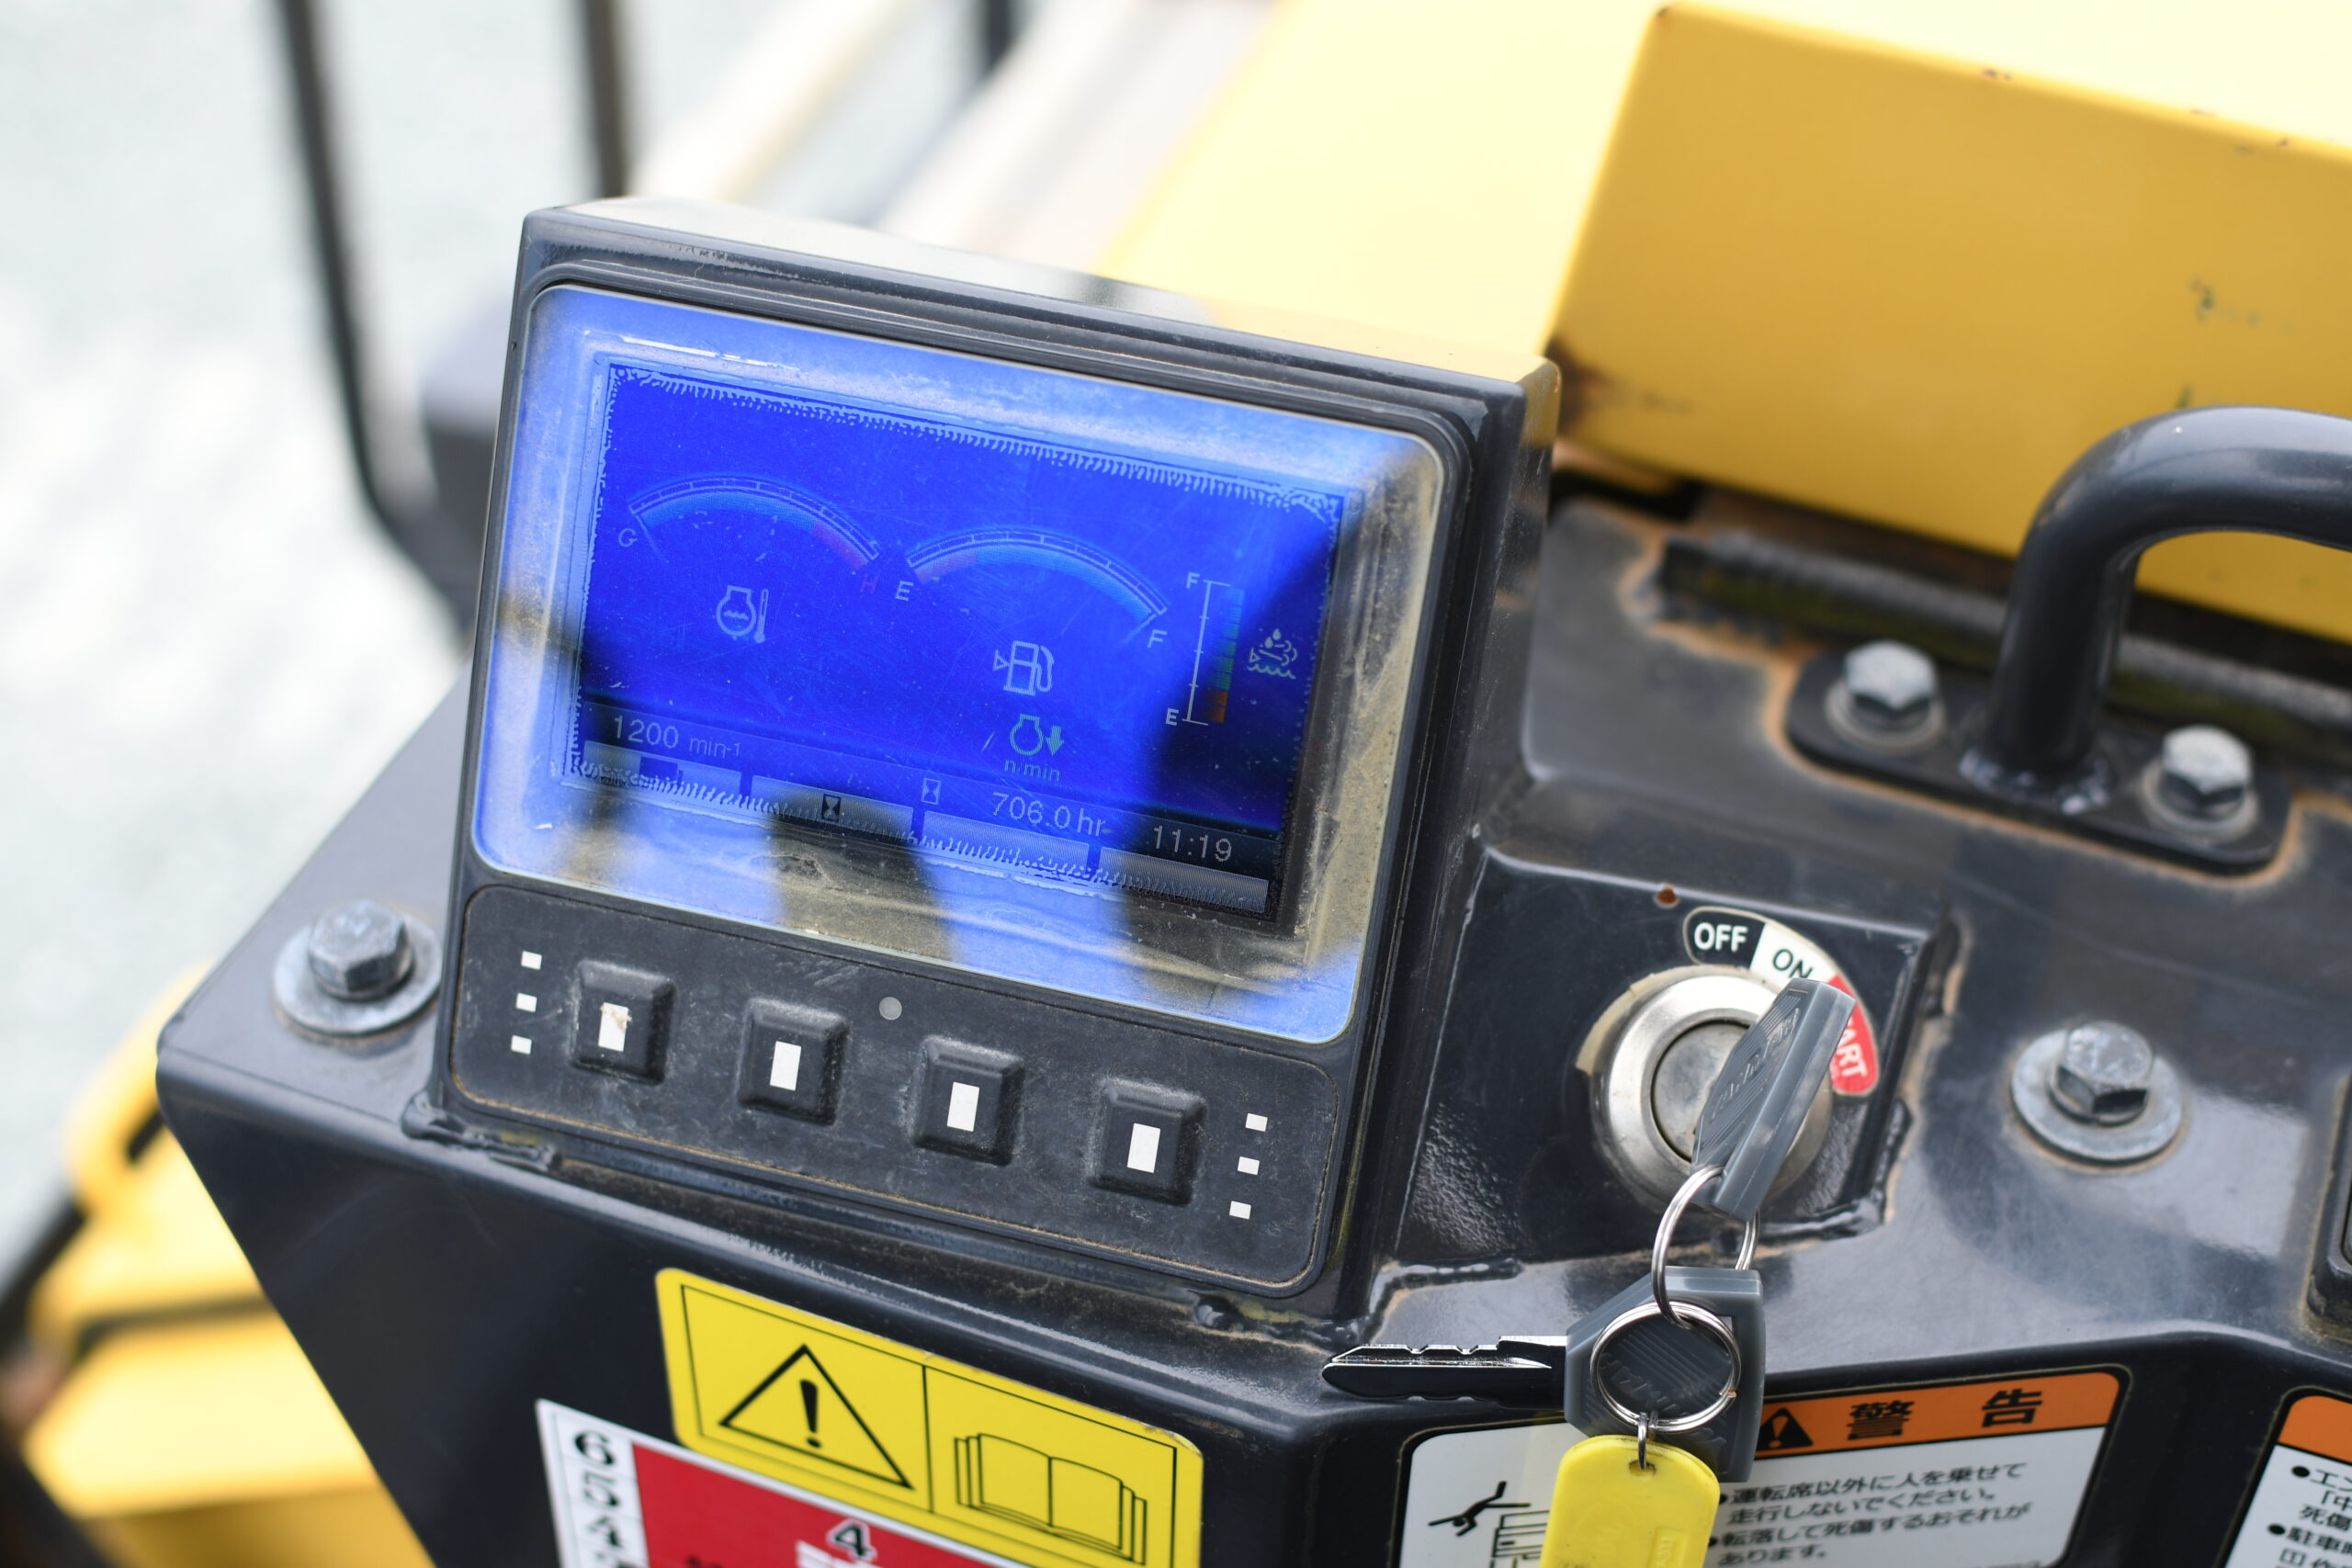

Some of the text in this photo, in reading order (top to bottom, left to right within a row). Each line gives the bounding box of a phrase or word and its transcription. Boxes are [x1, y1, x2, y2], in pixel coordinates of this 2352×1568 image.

[895, 581, 914, 602] E
[1186, 572, 1200, 589] F
[1148, 629, 1168, 649] F
[613, 715, 680, 750] 1200
[1165, 707, 1180, 726] E
[1004, 759, 1061, 783] n/min
[992, 791, 1107, 837] 706.0 hr
[1153, 825, 1233, 863] 11:19
[1693, 922, 1748, 953] OFF
[1771, 949, 1814, 979] ON
[1838, 1020, 1868, 1078] ART
[1847, 1388, 2043, 1441] 警告
[575, 1430, 615, 1466] 6
[582, 1470, 620, 1507] 5
[1730, 1461, 2028, 1505] 運転席以外に人を乗せて
[1727, 1487, 1996, 1525] 走行しないでください。
[587, 1516, 625, 1550] 4
[831, 1522, 873, 1559] 4
[1722, 1501, 2033, 1547] 転落して死傷するおそれが
[1718, 1543, 1828, 1566] あります。
